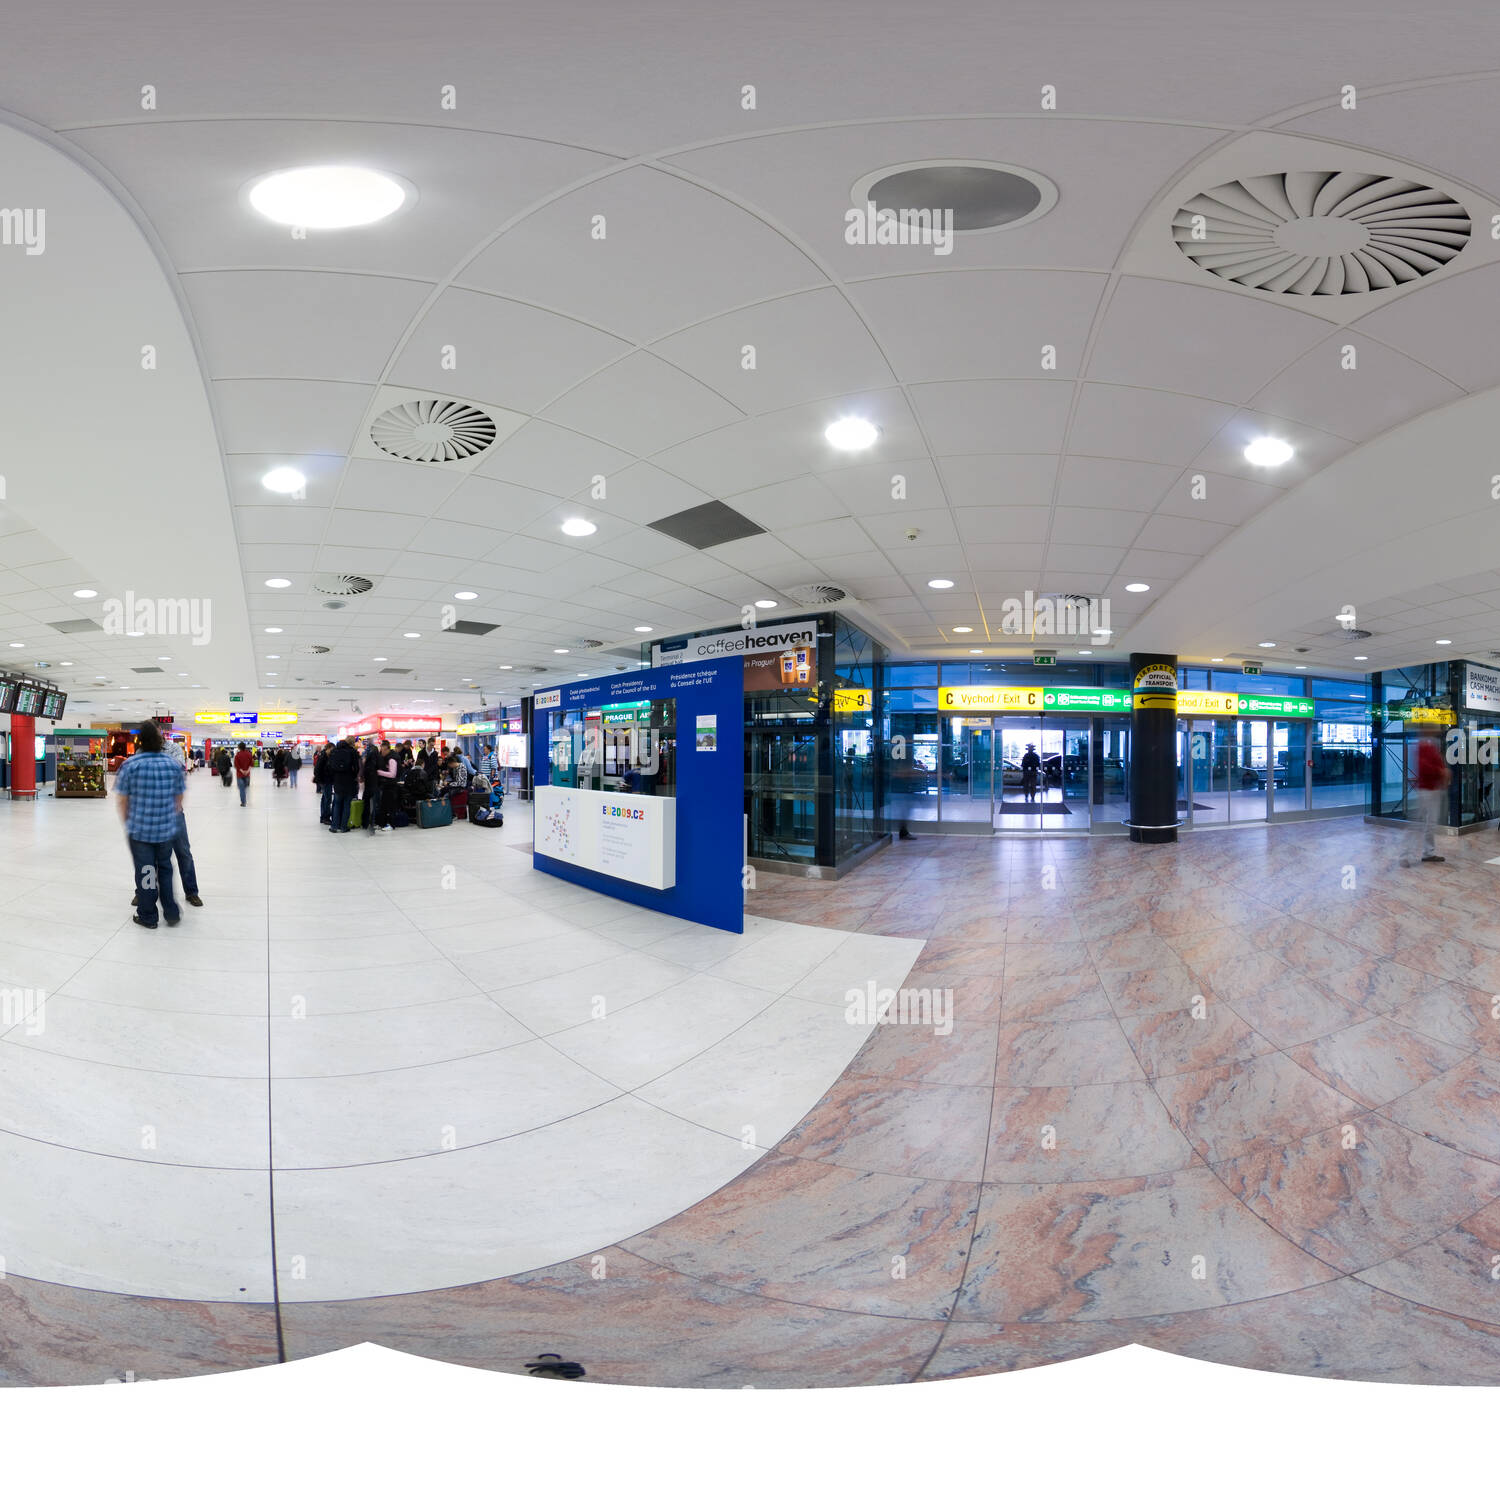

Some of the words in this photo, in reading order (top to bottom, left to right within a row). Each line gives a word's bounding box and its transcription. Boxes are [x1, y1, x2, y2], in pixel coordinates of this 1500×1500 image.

[697, 630, 813, 656] coffeeheaven
[1470, 671, 1498, 684] BANKOMAT
[946, 693, 953, 704] C
[1003, 694, 1020, 703] Exit
[1028, 693, 1036, 704] C
[1177, 698, 1197, 707] chod
[1225, 698, 1232, 709] C
[605, 713, 633, 721] PRAGUE
[602, 805, 644, 820] EU2009.CZ
